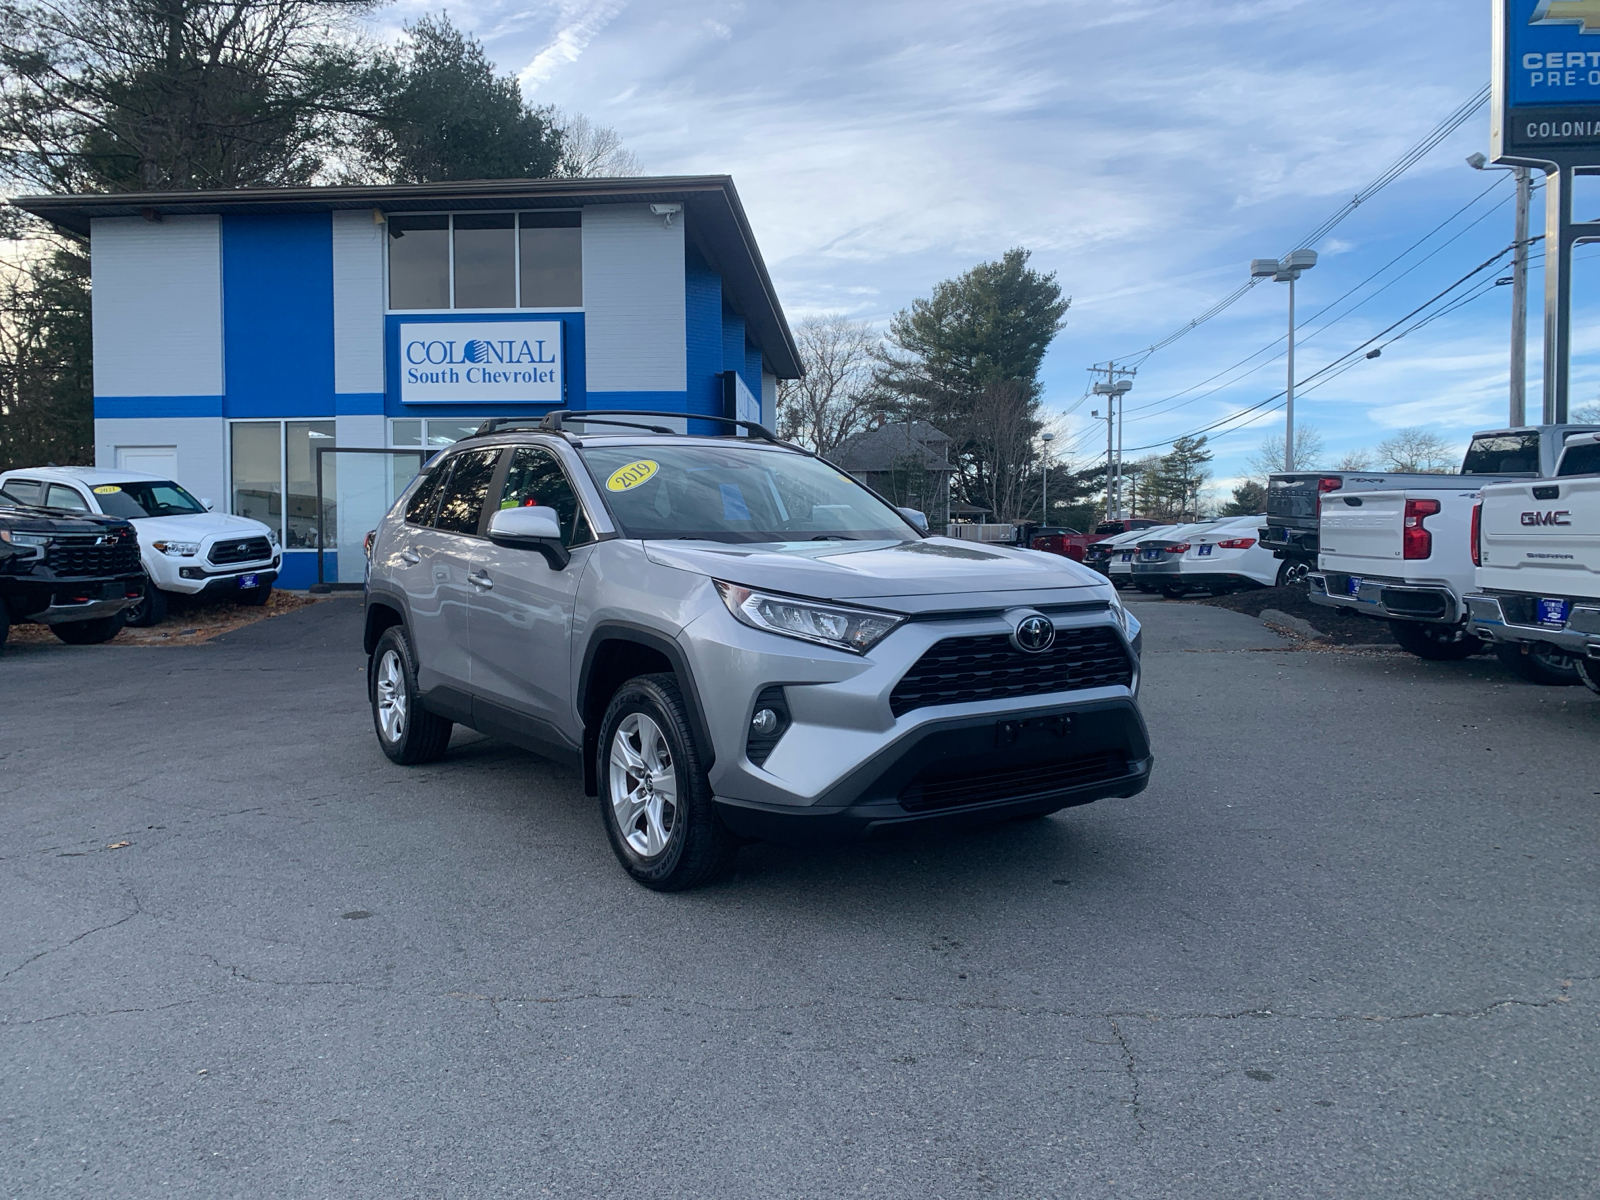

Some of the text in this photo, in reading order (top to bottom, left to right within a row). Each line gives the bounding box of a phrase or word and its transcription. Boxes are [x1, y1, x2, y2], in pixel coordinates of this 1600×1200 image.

[1522, 52, 1600, 69] CERT
[1531, 70, 1600, 87] PRE-O
[406, 339, 556, 365] COLONIAL
[408, 367, 556, 384] South Chevrolet
[615, 463, 651, 488] 2019
[1521, 510, 1572, 526] GMC
